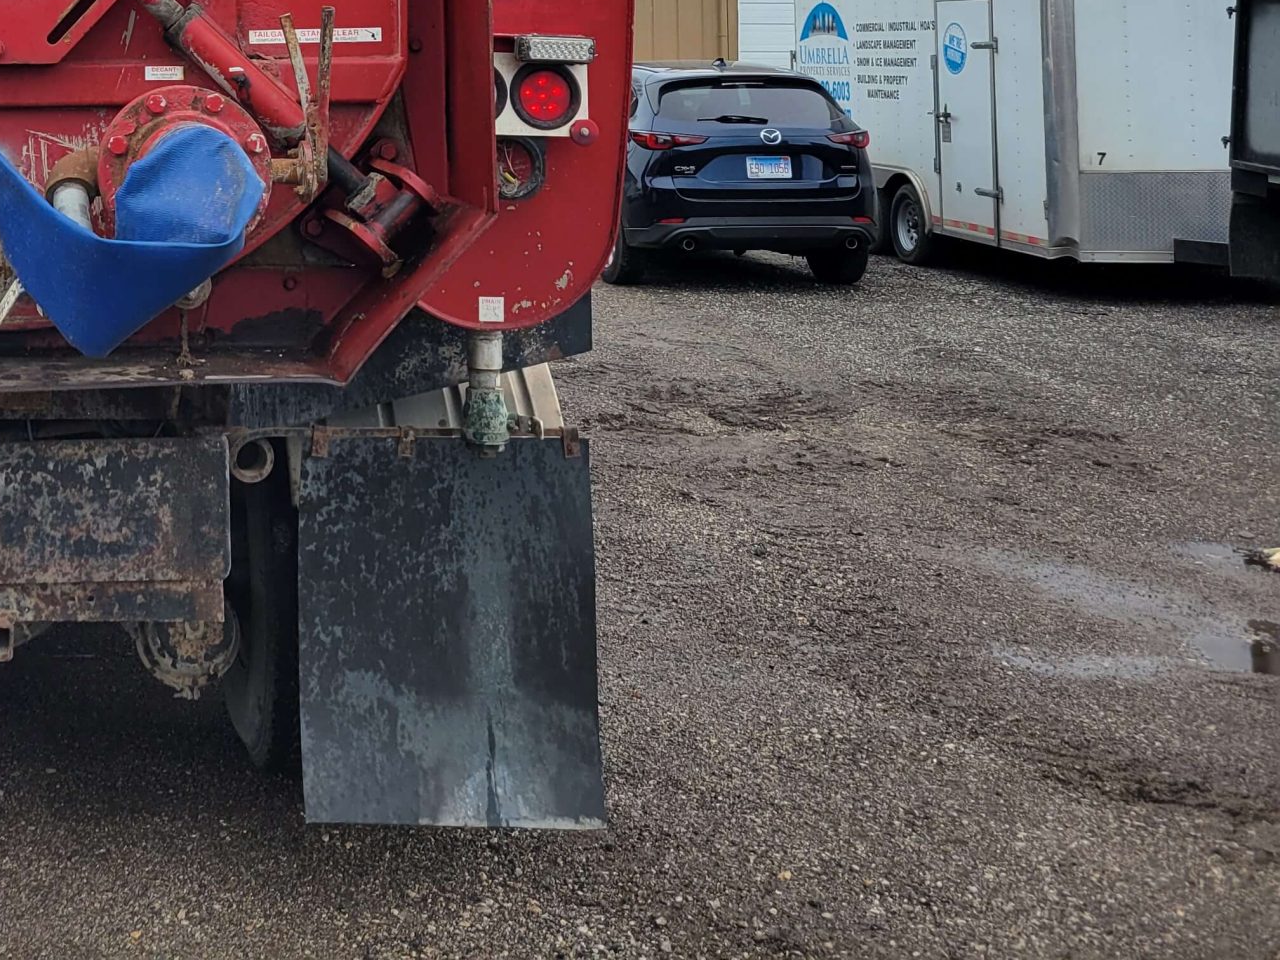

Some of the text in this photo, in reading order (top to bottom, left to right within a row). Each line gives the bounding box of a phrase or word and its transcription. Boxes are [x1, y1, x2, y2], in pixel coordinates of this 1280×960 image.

[855, 22, 885, 32] COMMERCIAL
[888, 21, 917, 31] INDUSTRIAL
[856, 39, 916, 50] LANDSCAPE MANAGEMENT
[799, 45, 849, 65] UMBRELLA
[856, 57, 870, 67] SNOW
[875, 57, 883, 67] ICE
[883, 57, 917, 68] MANAGEMENT
[799, 66, 851, 76] PROPERTY SERVICES
[857, 74, 878, 84] BUILDING
[883, 75, 908, 86] PROPERTY
[867, 89, 900, 100] MAINTENANCE
[1097, 152, 1107, 166] 7
